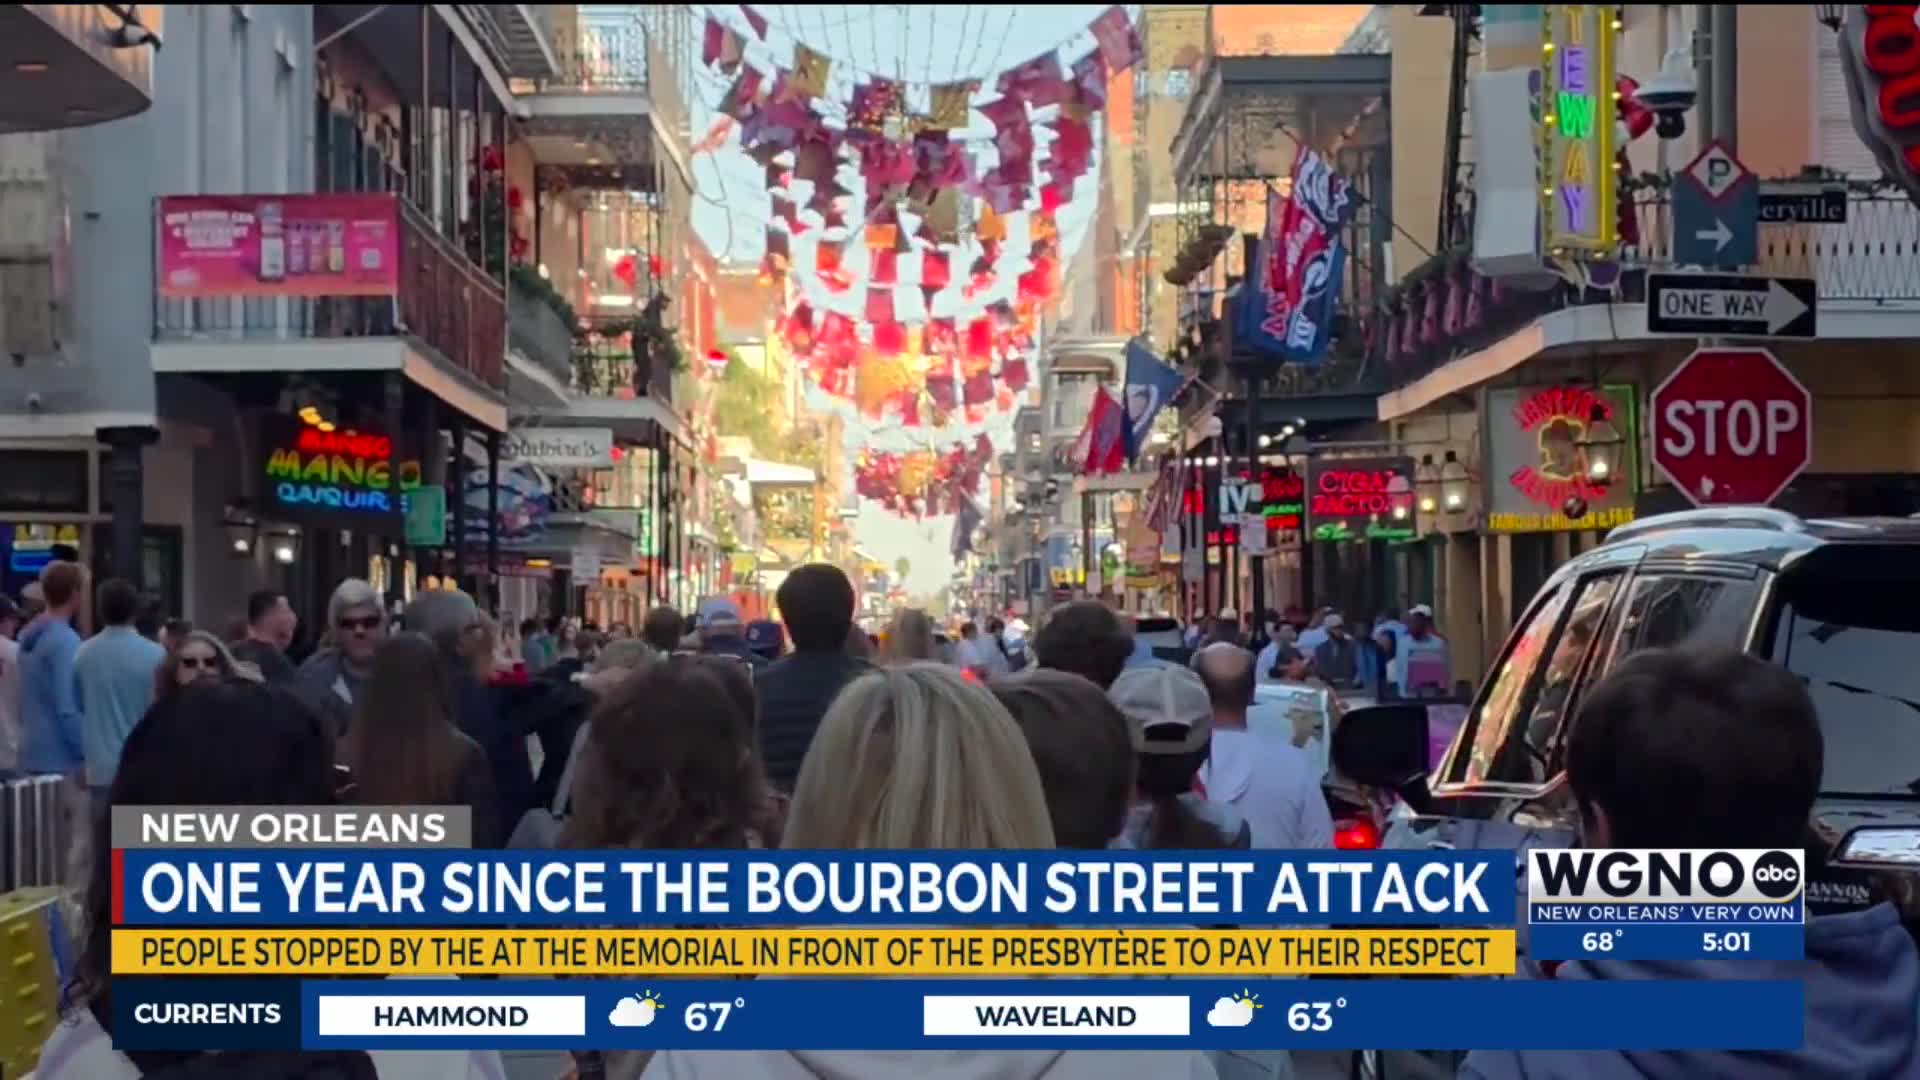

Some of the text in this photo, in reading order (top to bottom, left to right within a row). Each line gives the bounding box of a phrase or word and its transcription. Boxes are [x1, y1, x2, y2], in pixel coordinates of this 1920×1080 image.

[1708, 158, 1731, 186] P
[1760, 203, 1842, 219] erville
[1665, 292, 1766, 317] ONE WAY
[1673, 400, 1798, 457] STOP
[1319, 471, 1408, 492] CIGA
[1806, 881, 1870, 898] ANNON
